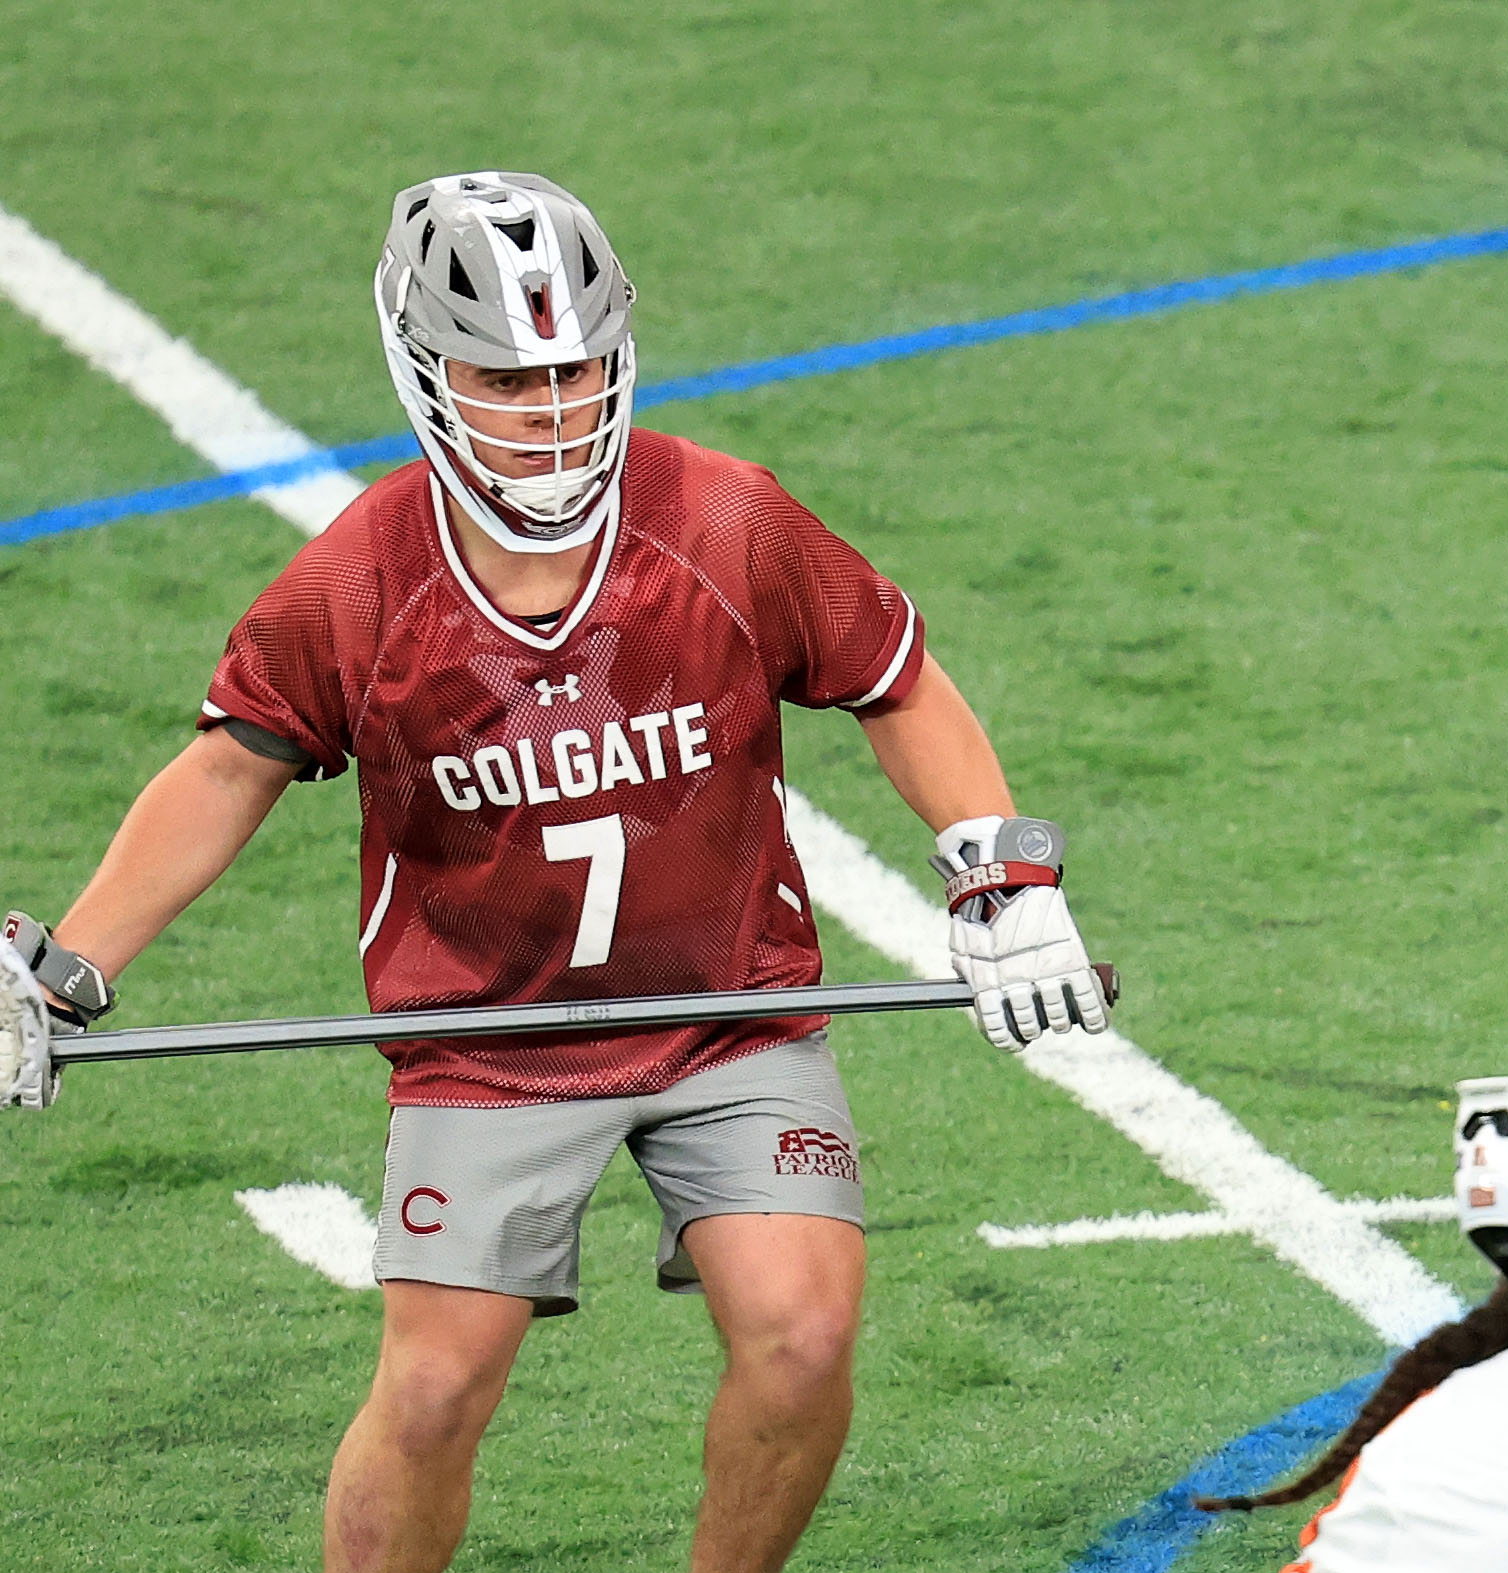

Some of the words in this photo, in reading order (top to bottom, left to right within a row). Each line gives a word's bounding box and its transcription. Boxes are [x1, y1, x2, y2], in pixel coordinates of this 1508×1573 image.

[431, 702, 712, 811] COLGATE
[541, 813, 626, 968] 7
[400, 1185, 451, 1238] C
